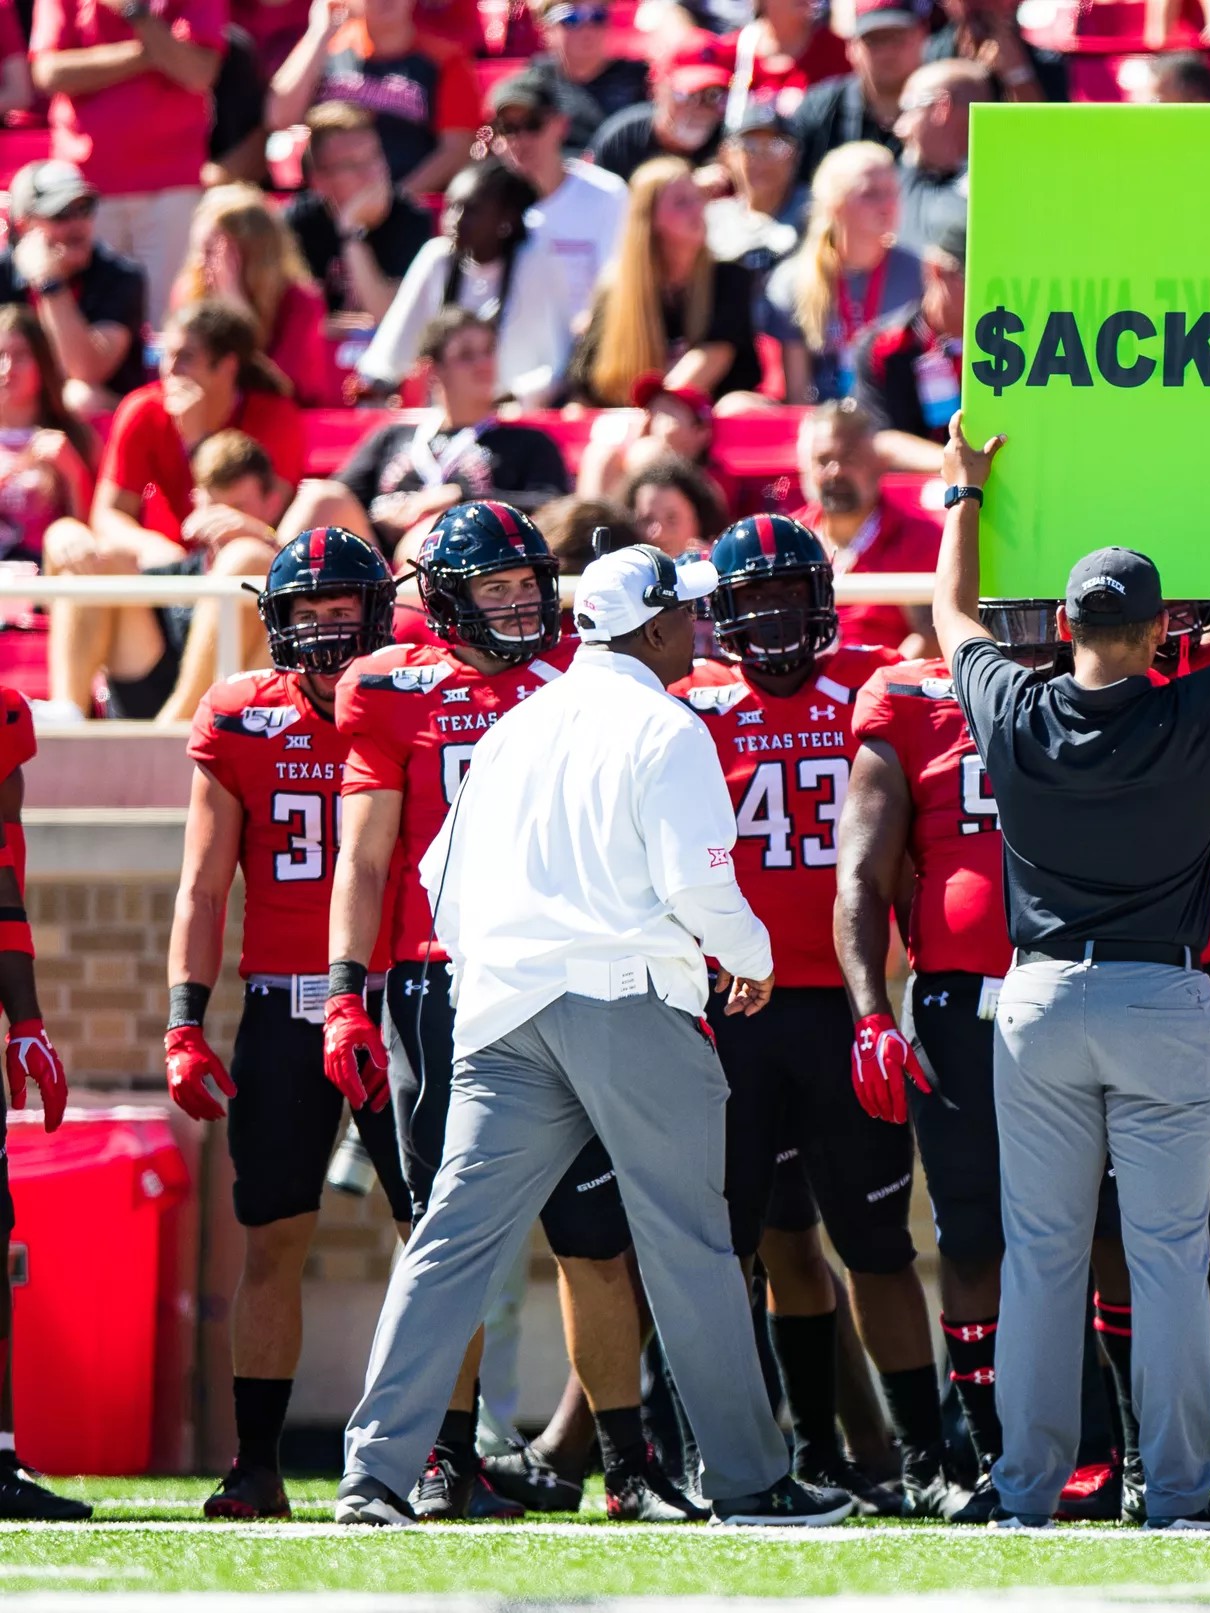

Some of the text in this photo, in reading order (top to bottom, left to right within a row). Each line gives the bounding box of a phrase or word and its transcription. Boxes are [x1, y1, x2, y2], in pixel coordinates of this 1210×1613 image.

[1081, 576, 1126, 594] TEXAS TECH
[437, 711, 498, 732] TEXAS
[734, 731, 845, 753] TEXAS TECH
[275, 762, 334, 780] TEXAS
[735, 755, 851, 870] 43
[270, 789, 343, 883] 3
[576, 1172, 612, 1192] GUNS
